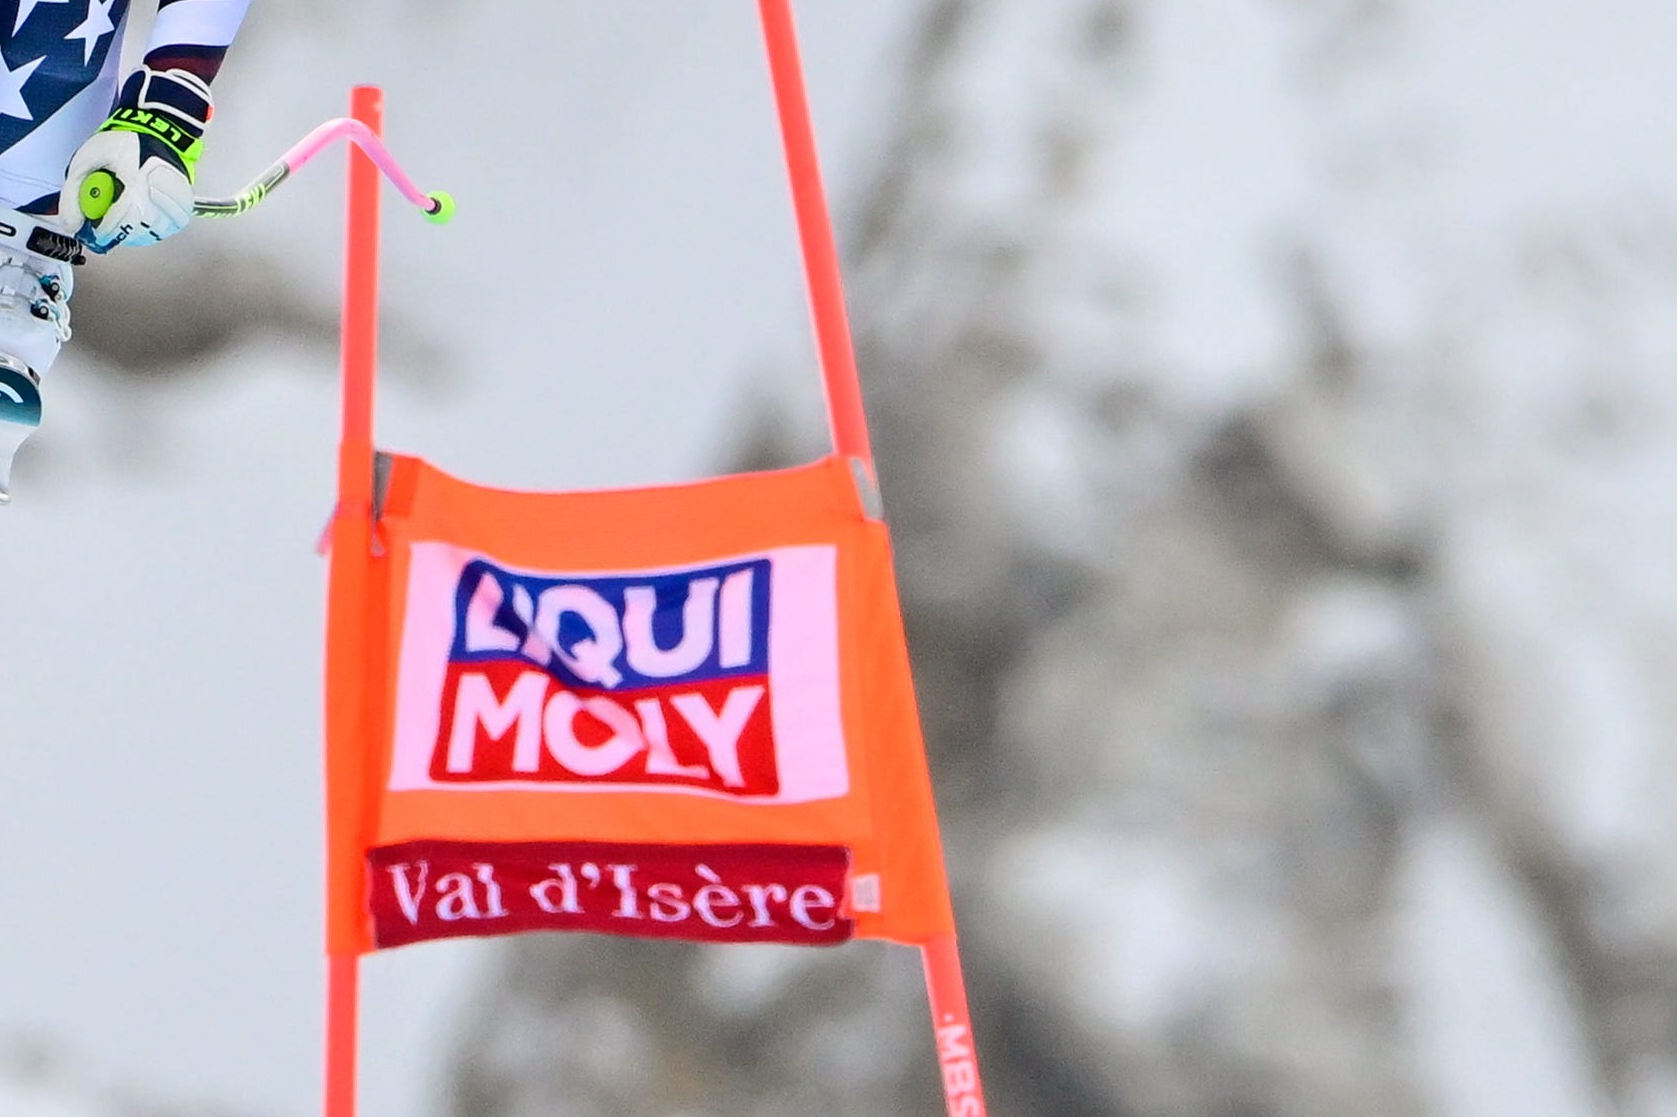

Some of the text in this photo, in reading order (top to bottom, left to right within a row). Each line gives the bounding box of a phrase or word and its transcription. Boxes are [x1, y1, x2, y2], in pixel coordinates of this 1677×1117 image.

[120, 108, 182, 142] LEKI
[464, 568, 755, 690] LIQUI
[445, 670, 765, 788] MOLY
[387, 859, 836, 931] Val d'Isère
